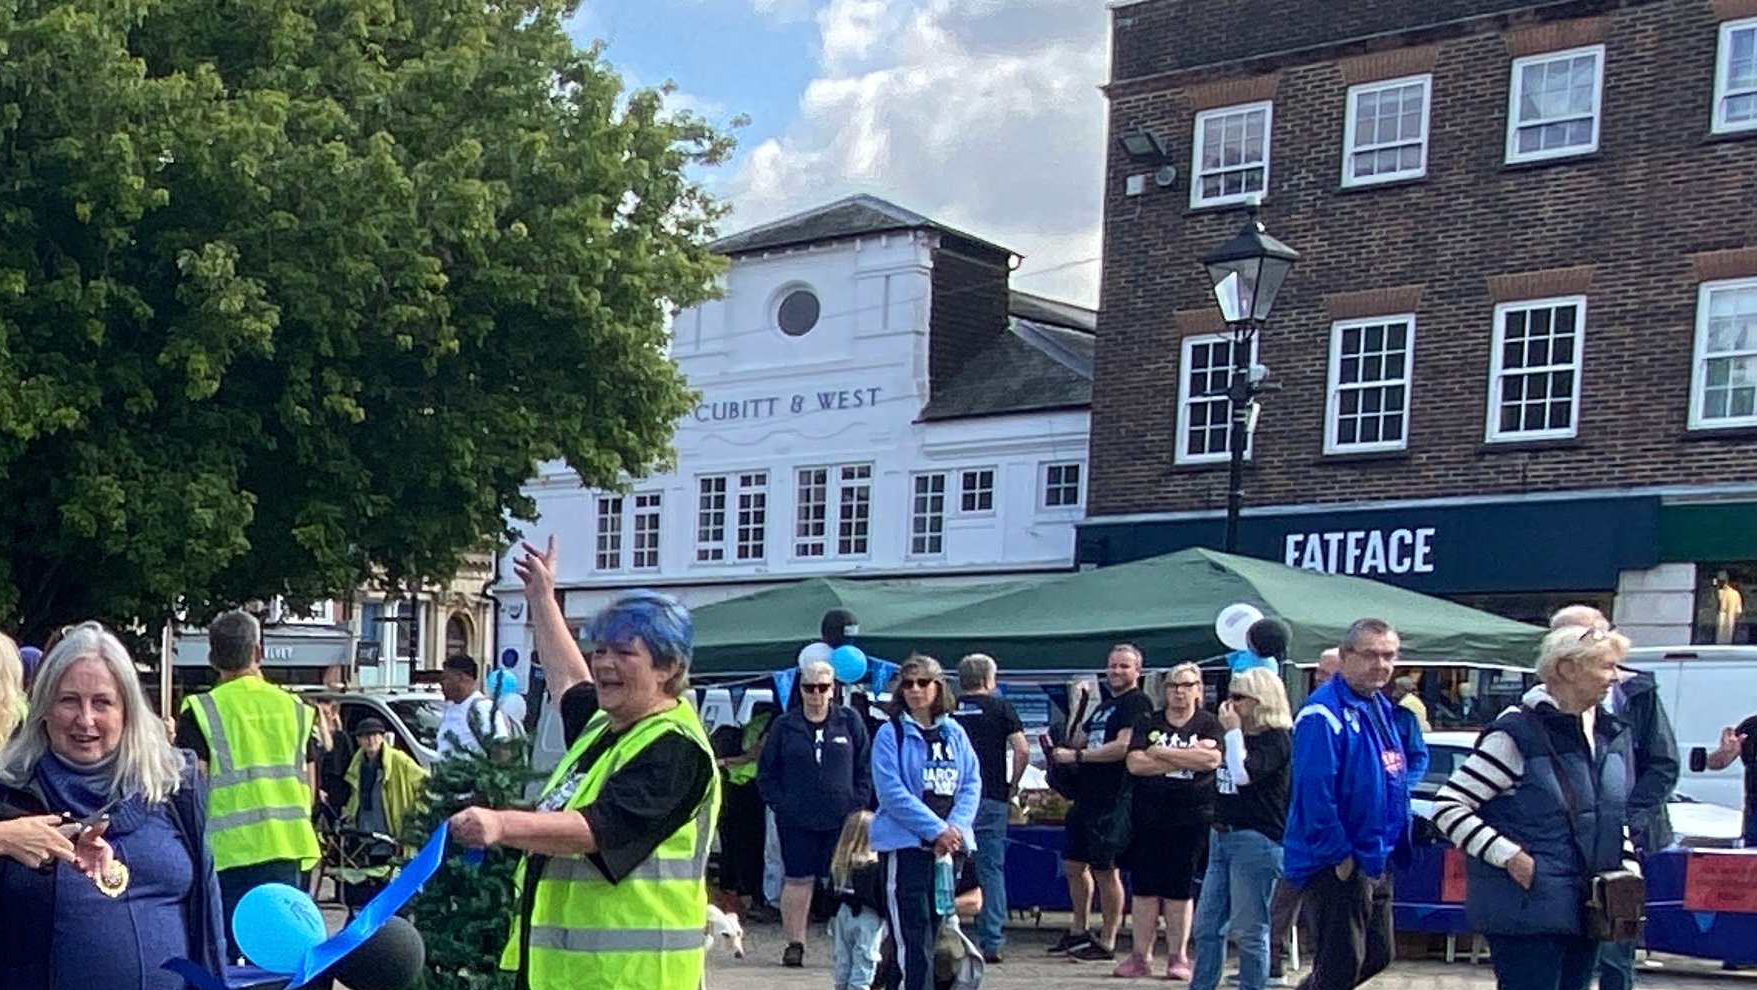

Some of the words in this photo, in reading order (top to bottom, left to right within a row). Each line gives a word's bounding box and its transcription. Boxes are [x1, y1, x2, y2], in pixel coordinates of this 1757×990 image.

[694, 397, 780, 423] CUBITT
[790, 394, 805, 414] &
[817, 386, 882, 410] WEST
[1285, 527, 1436, 575] FATFACE
